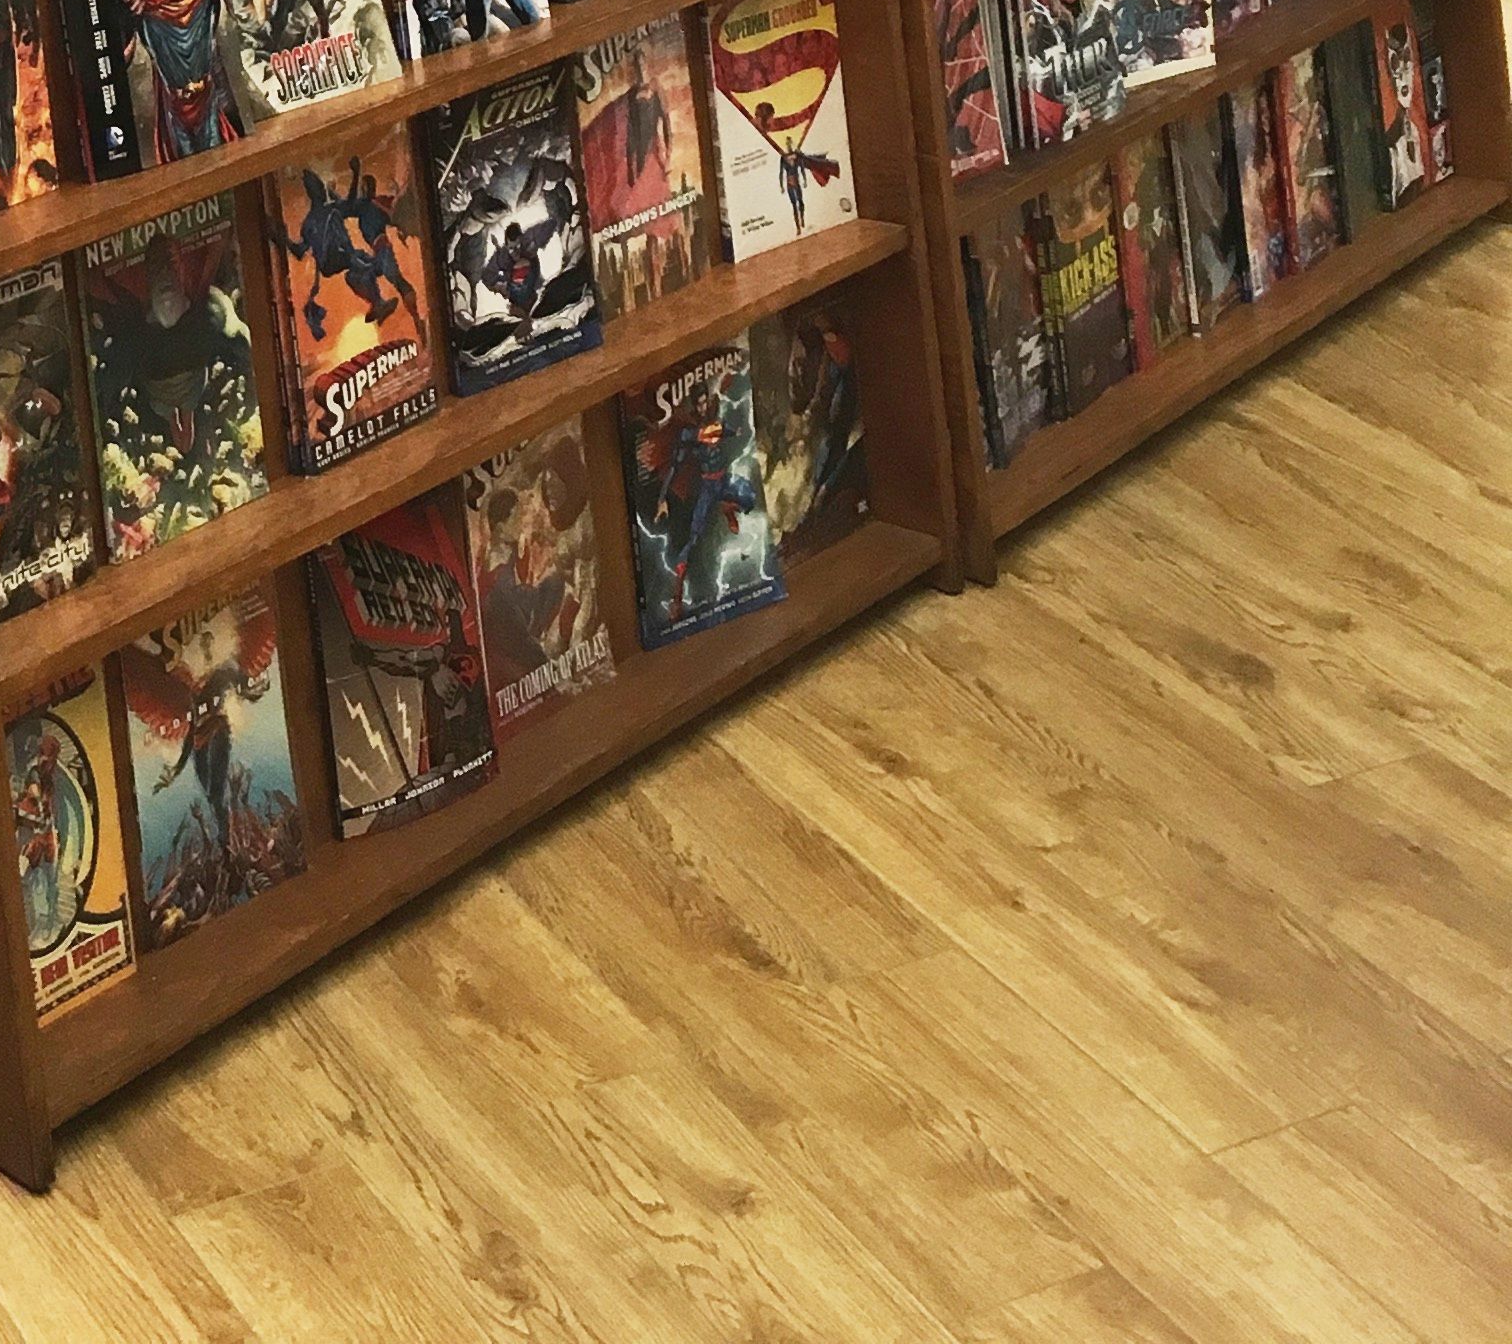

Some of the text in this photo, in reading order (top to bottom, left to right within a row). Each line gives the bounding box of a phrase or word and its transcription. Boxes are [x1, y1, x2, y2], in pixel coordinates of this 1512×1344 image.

[725, 11, 771, 44] SUPERMAN
[1044, 38, 1116, 96] THOR
[463, 68, 565, 141] ACTION
[85, 195, 221, 269] NEW KRYPTON
[601, 188, 699, 243] SHADOWS LINGER
[326, 342, 418, 436] SUPERMAN
[656, 349, 743, 425] SUPERMAN
[315, 388, 436, 460] CAMELOT FALLS
[496, 632, 608, 717] THE COMING OF ATLAS
[362, 797, 397, 815] MILLAR
